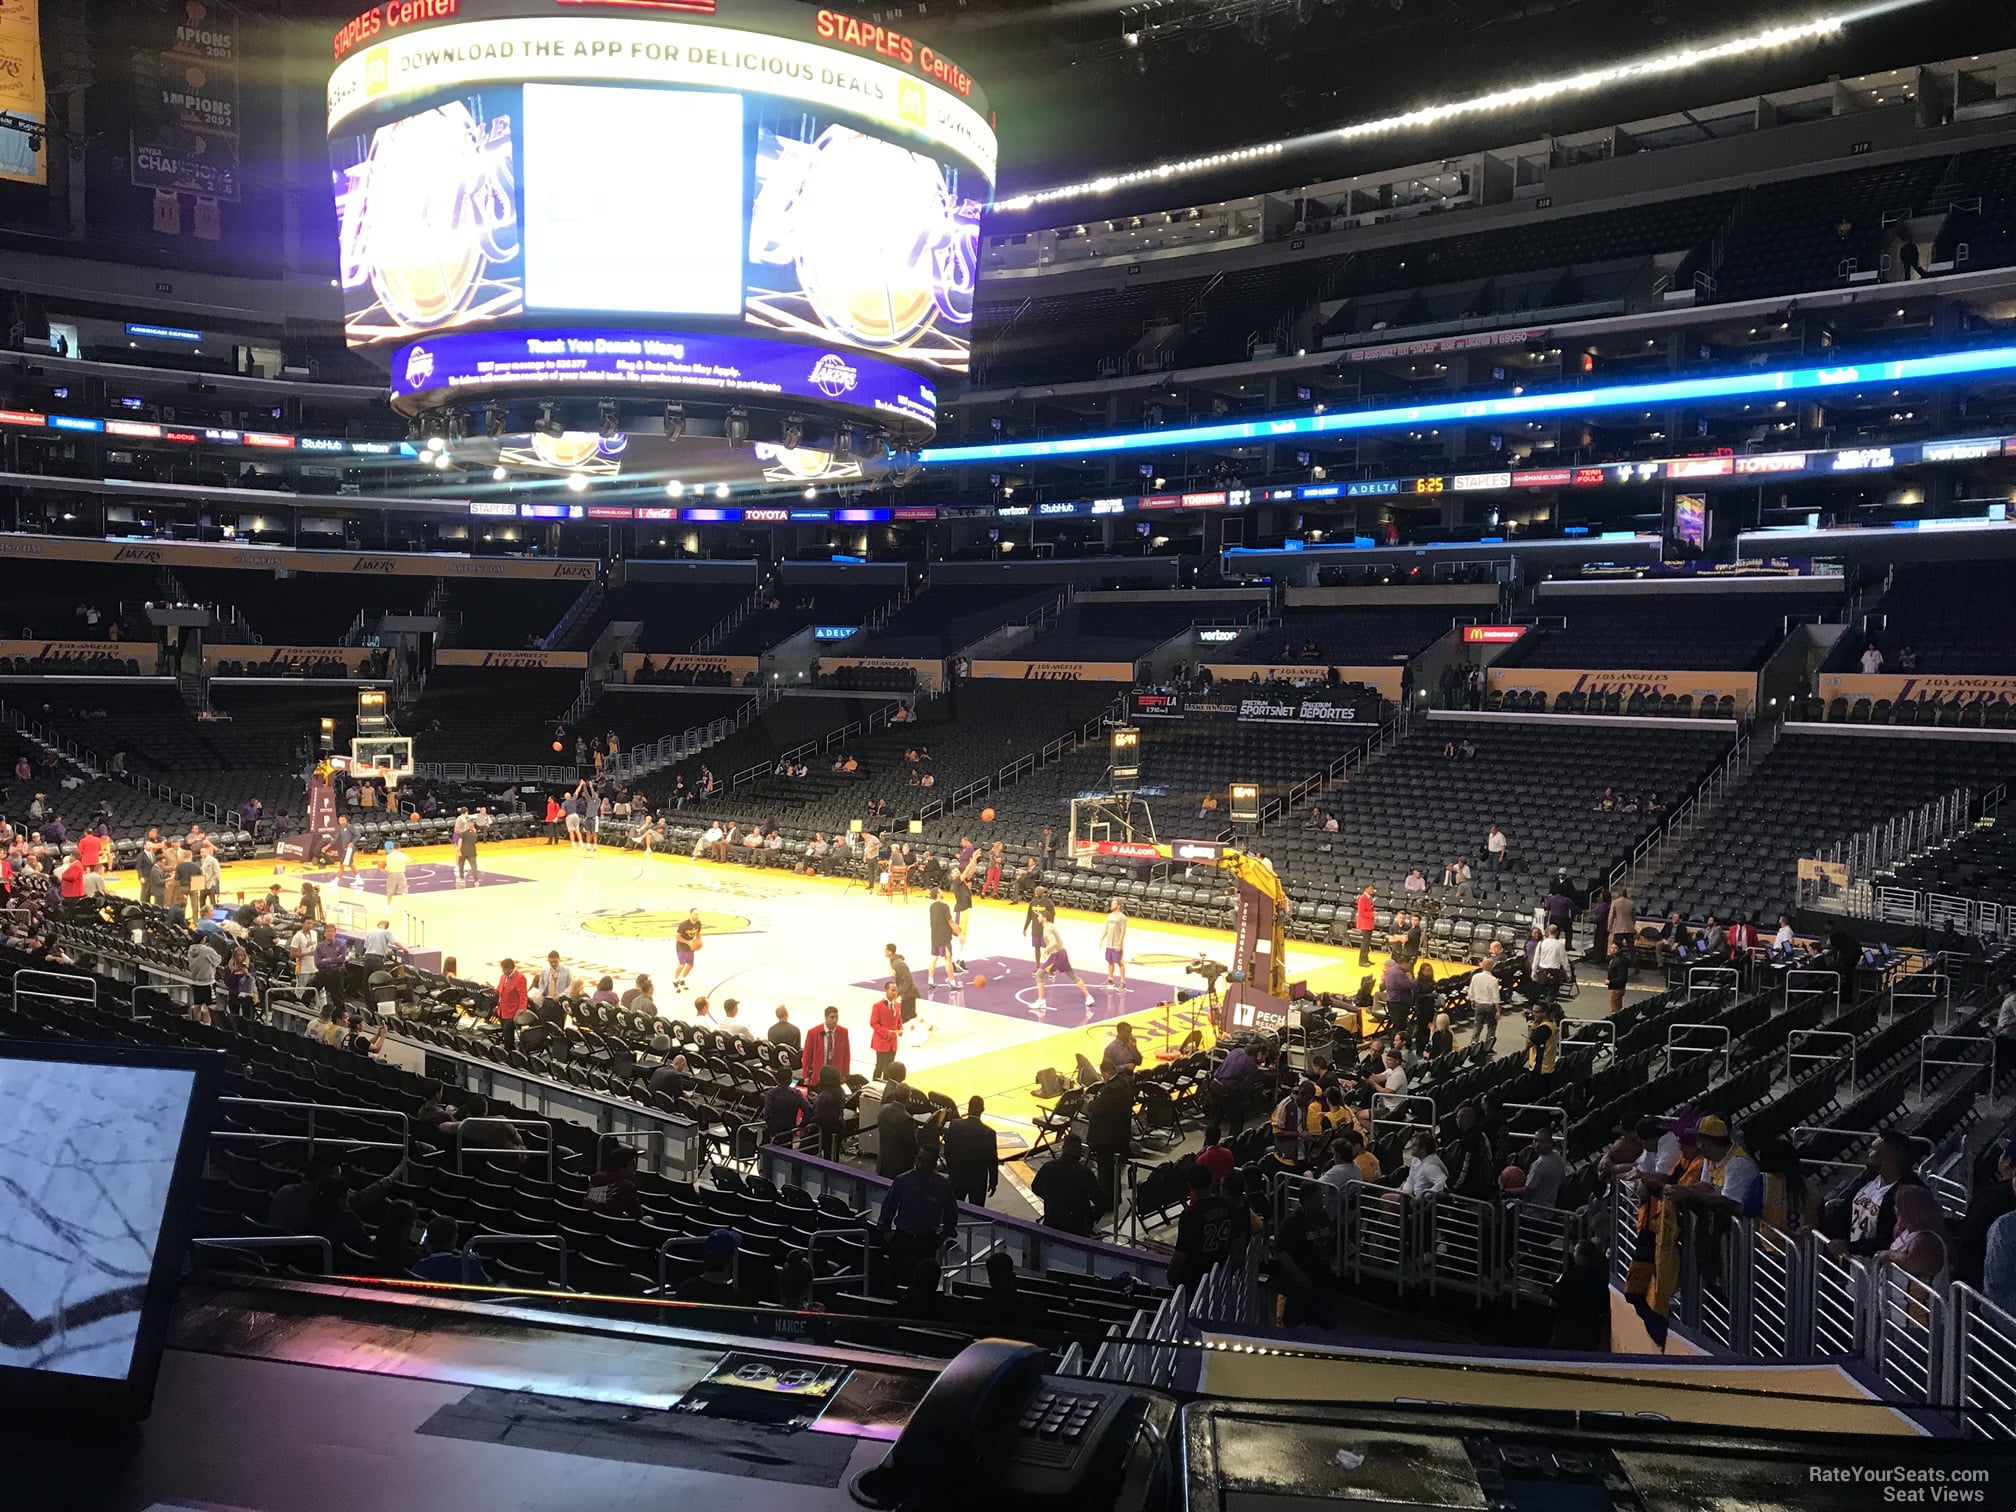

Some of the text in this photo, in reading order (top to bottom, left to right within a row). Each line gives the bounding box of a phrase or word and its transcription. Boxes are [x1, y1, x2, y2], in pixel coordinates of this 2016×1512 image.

[333, 0, 458, 60] STAPLES Center
[817, 9, 973, 97] STAPLES Center
[401, 40, 885, 100] DOWNLOAD THE APP FOR DELICIOUS DEALS
[1854, 143, 1869, 153] 319
[131, 326, 167, 336] AMERICAN
[1498, 332, 1528, 344] 69050
[527, 337, 594, 354] Thank You
[301, 438, 342, 450] StubHub
[352, 443, 390, 454] verizon
[1735, 456, 1805, 472] TOYOTA
[1416, 477, 1443, 492] 6:25
[1456, 475, 1508, 489] STAPLES
[1577, 475, 1603, 483] FOULS
[1361, 483, 1397, 494] DELTA
[1182, 493, 1225, 505] TOSHIBA
[471, 504, 515, 514] STAPLES
[998, 505, 1029, 516] verizon
[1040, 503, 1074, 514] StubHub
[745, 510, 788, 520] TOYOTA
[113, 545, 162, 563] LAKERS
[352, 557, 396, 573] LAKERS
[553, 563, 593, 578] LAKERS
[1200, 631, 1237, 641] verizon
[1596, 673, 1668, 682] LOS ANGELES
[1925, 678, 2016, 688] LOS ANGELES
[1138, 695, 1177, 706] ESPN LA
[1302, 701, 1332, 709] SPECTRUM
[1184, 703, 1237, 713] LAKERS.COM
[1240, 705, 1355, 719] SPORTSNET DEPORTES
[1118, 844, 1156, 857] AAA.com
[1257, 1011, 1286, 1025] PECH
[1203, 1219, 1231, 1252] 24
[774, 1318, 807, 1334] NANCE
